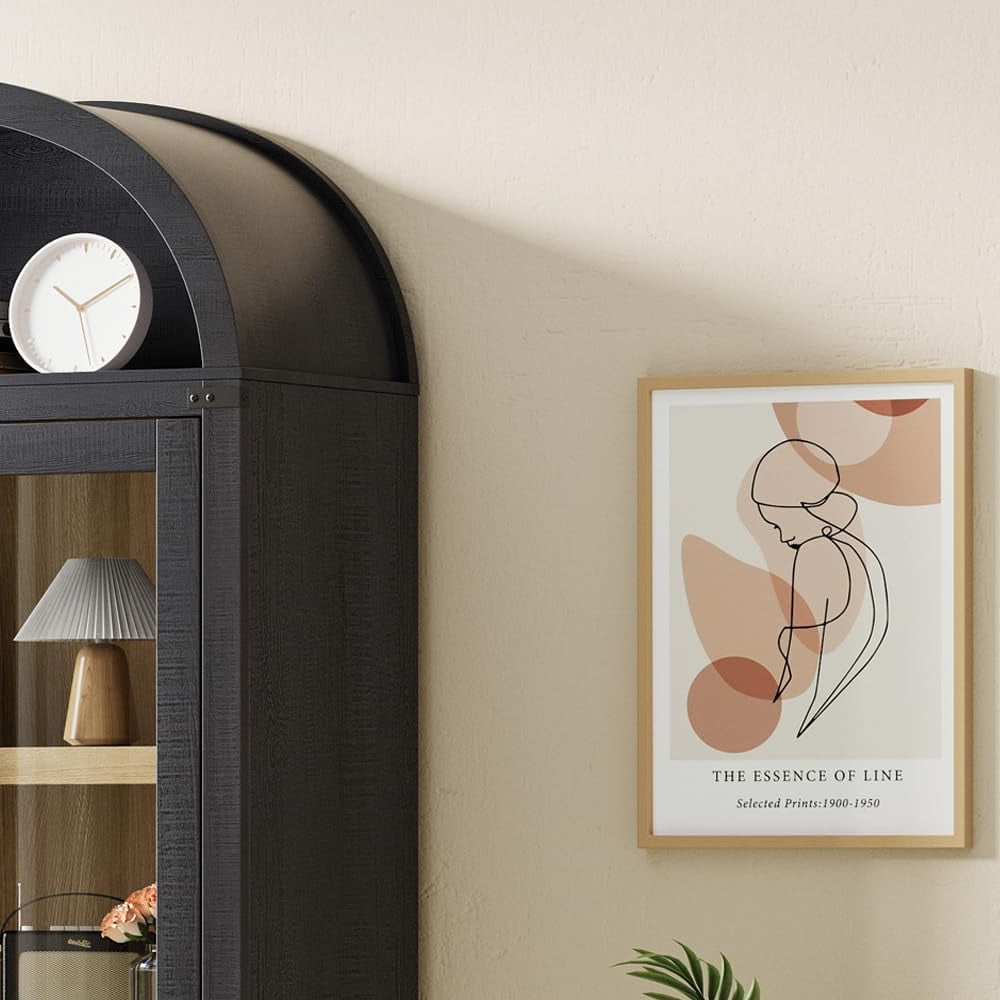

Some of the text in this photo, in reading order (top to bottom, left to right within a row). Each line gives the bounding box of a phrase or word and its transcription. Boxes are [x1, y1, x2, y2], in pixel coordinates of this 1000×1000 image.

[712, 769, 904, 782] THE ESSENCE OF LINE
[736, 798, 781, 808] Selected
